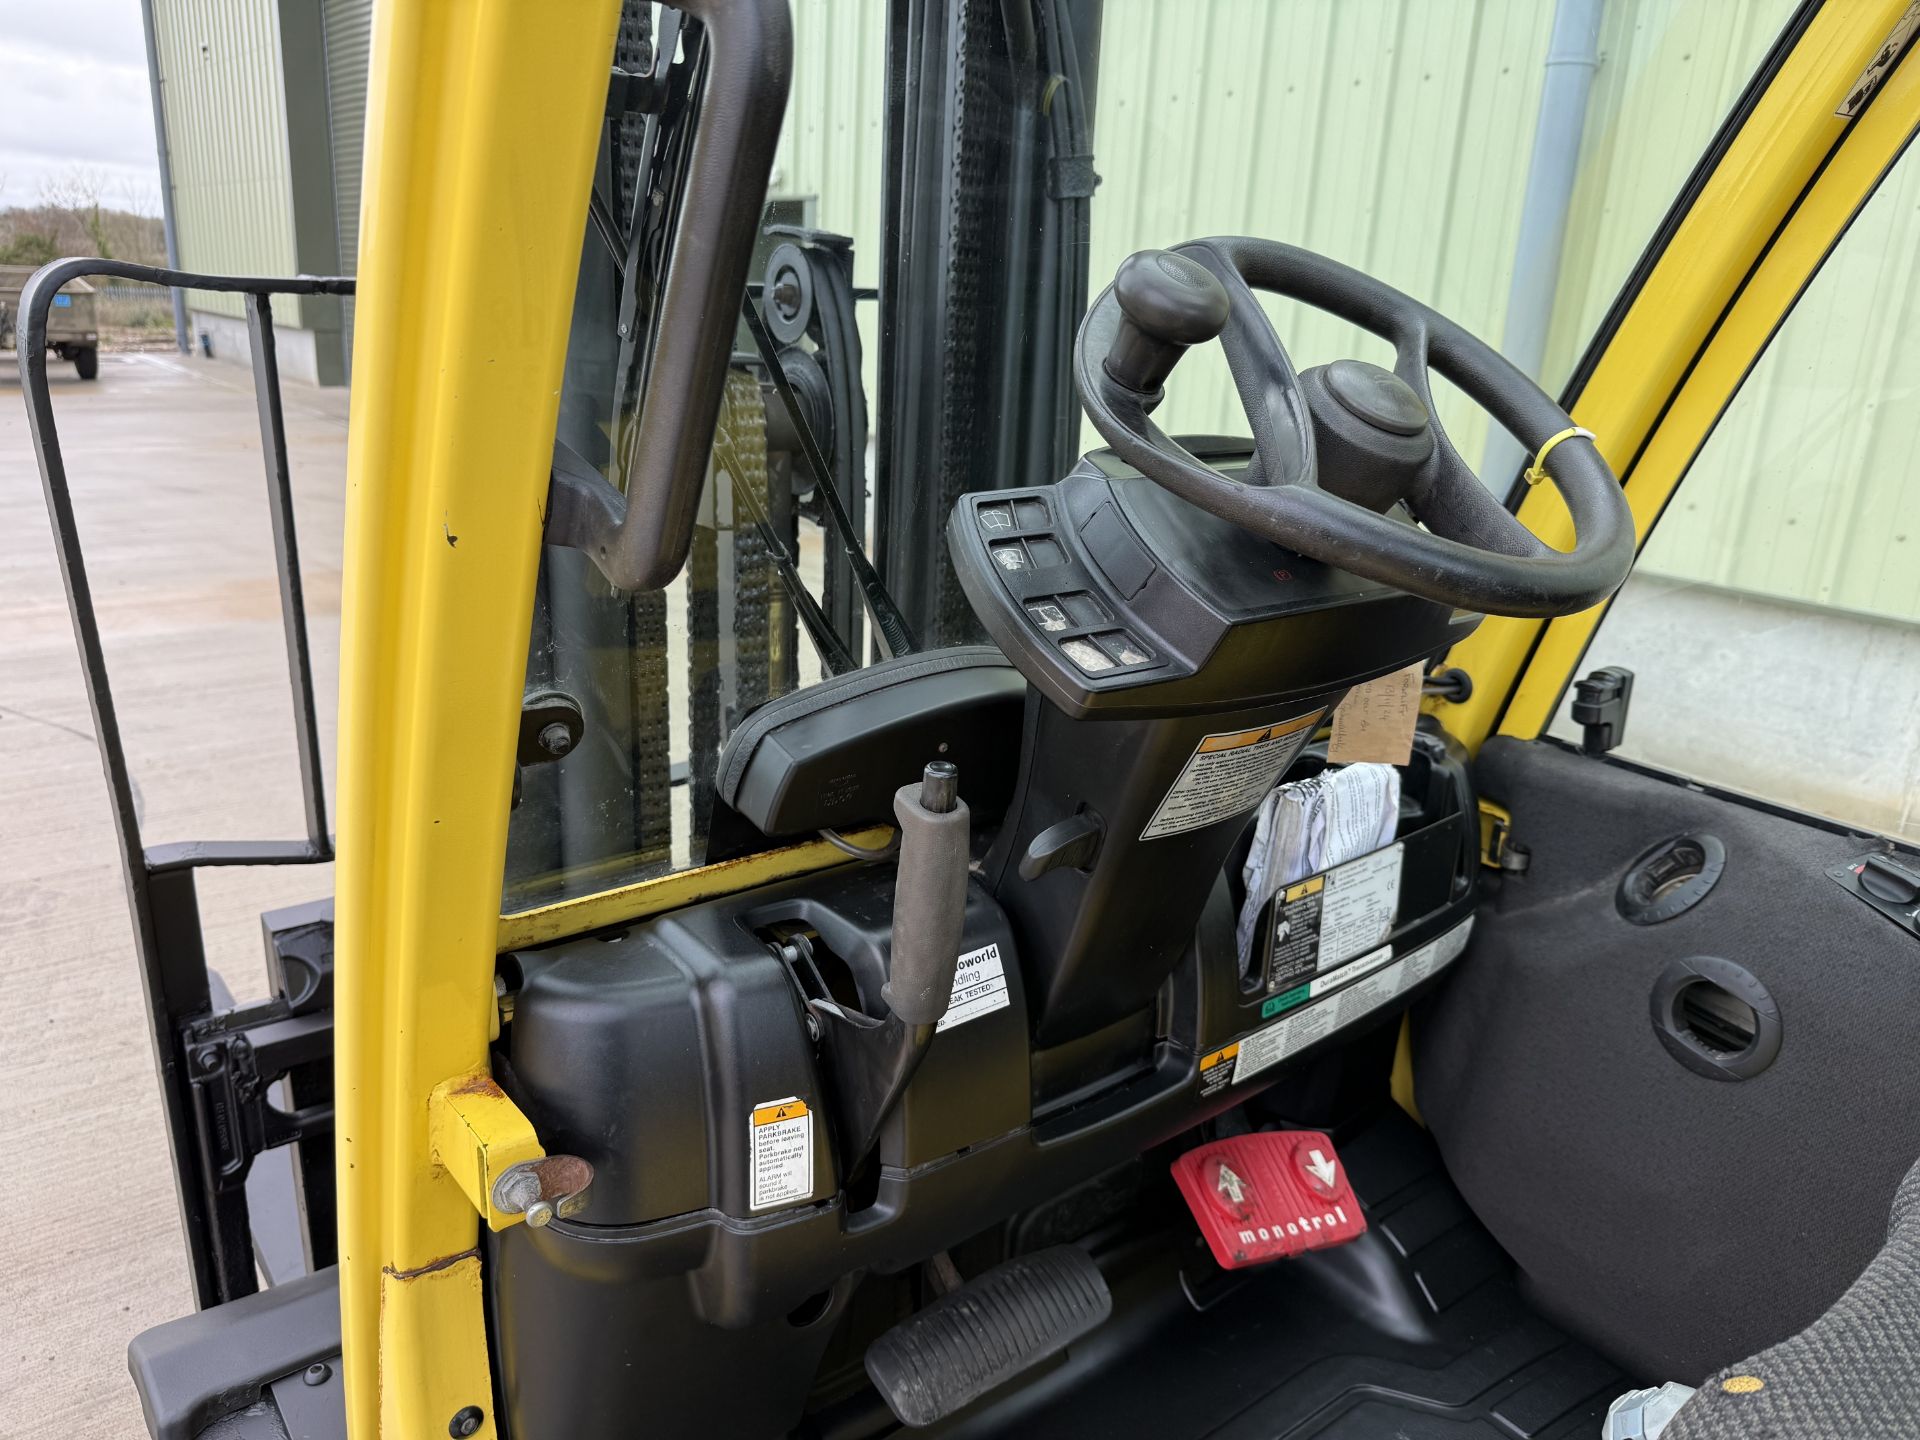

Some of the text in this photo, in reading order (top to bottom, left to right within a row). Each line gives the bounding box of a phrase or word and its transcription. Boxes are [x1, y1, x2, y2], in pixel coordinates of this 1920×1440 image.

[758, 1123, 781, 1134] APPLY
[758, 1126, 801, 1141] PARKBRAKE
[758, 1132, 805, 1147] before leaving
[759, 1144, 804, 1160] Parkbrake not
[759, 1151, 803, 1167] automatically
[759, 1173, 782, 1182] ALARM
[759, 1180, 777, 1189] sound
[759, 1183, 788, 1196] parkbrake
[765, 1192, 775, 1201] not
[1238, 1205, 1348, 1245] monotrol
